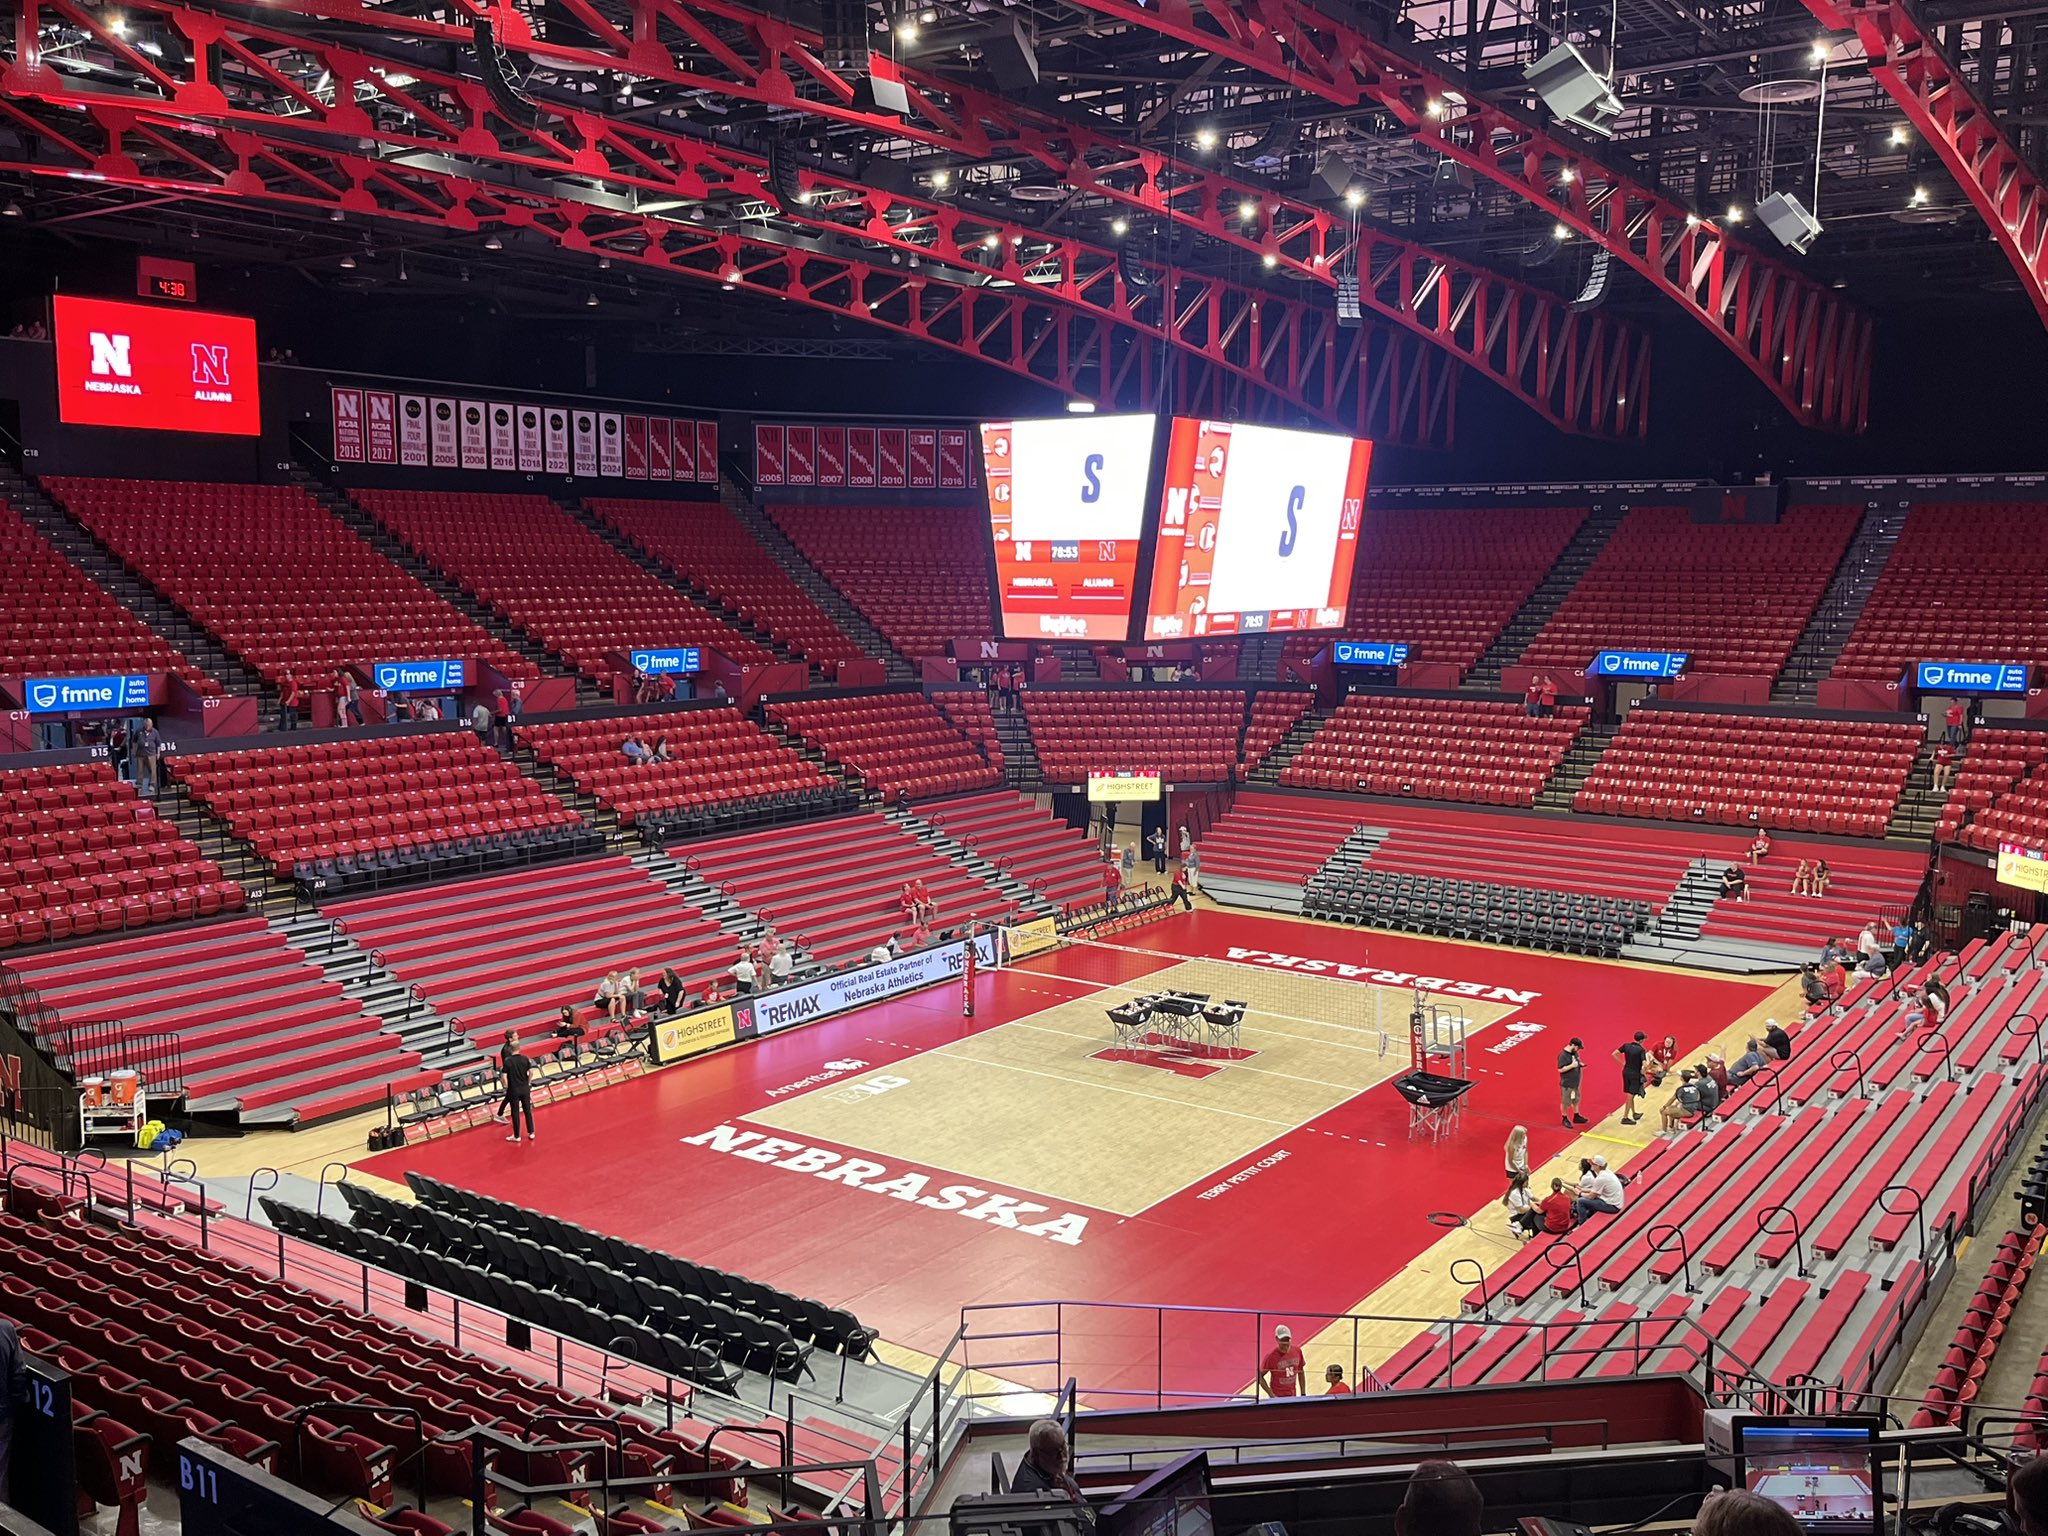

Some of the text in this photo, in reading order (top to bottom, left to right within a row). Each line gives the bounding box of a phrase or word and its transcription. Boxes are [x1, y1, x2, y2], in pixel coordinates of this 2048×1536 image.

[159, 281, 185, 296] 4:38
[90, 331, 132, 377] N
[191, 343, 229, 385] N
[85, 381, 142, 395] NEBRASKA
[194, 390, 232, 402] ALUMNI
[337, 393, 359, 418] N
[370, 396, 392, 420] N
[338, 420, 359, 429] NCAA
[371, 422, 391, 431] NCAA
[23, 448, 39, 457] C18
[339, 445, 361, 458] 2015
[372, 447, 392, 460] 2017
[404, 452, 426, 462] 2001
[435, 455, 456, 464] 2005
[493, 458, 513, 466] 2016
[548, 460, 568, 469] 2021
[576, 462, 596, 471] 2023
[602, 464, 621, 473] 2024
[652, 468, 670, 477] 2001
[675, 470, 693, 478] 2002
[760, 474, 782, 482] 2005
[790, 475, 812, 483] 2006
[821, 475, 842, 483] 2007
[851, 476, 872, 484] 2008
[882, 476, 903, 484] 2010
[1081, 453, 1104, 503] S
[913, 477, 933, 485] 2011
[942, 477, 962, 485] 2016
[1165, 488, 1188, 524] N
[1342, 498, 1360, 530] N
[1278, 485, 1305, 558] S
[1015, 542, 1031, 561] N
[1099, 541, 1115, 561] N
[1083, 578, 1114, 587] ALUMNI
[980, 641, 999, 658] N
[1146, 645, 1164, 657] N
[1353, 647, 1385, 660] fmne
[650, 655, 680, 669] fmne
[1623, 657, 1660, 671] fmne
[400, 669, 438, 684] fmne
[1947, 669, 1992, 684] fmne
[129, 687, 146, 695] farm
[511, 681, 525, 689] C18
[61, 685, 112, 703] fmne
[372, 689, 388, 698] C18
[2028, 688, 2042, 696] C7
[203, 699, 221, 708] C17
[10, 711, 30, 721] C17
[507, 714, 516, 723] B1
[1917, 714, 1927, 722] B5
[1974, 717, 1985, 725] B6
[459, 719, 472, 727] B16
[91, 747, 109, 757] B15
[160, 743, 177, 751] B16
[1106, 783, 1153, 791] HIGHSTREET
[314, 880, 326, 889] A14
[250, 890, 263, 899] A13
[948, 945, 989, 972] REAX
[830, 954, 933, 992] Official Real Estate Partner of
[1226, 946, 1542, 1003] NEBRASKA
[843, 971, 924, 1003] Nebraska Athletics
[769, 994, 821, 1026] REMAX
[736, 1008, 752, 1029] N
[676, 1016, 727, 1039] HIGHSTREET
[1196, 1149, 1292, 1200] TERRY PETTIT COURT
[680, 1125, 1090, 1246] NEBRASKA
[1285, 1366, 1295, 1378] N
[32, 1379, 54, 1418] 12
[119, 1449, 143, 1482] N
[180, 1454, 218, 1505] B11
[571, 1464, 586, 1483] N
